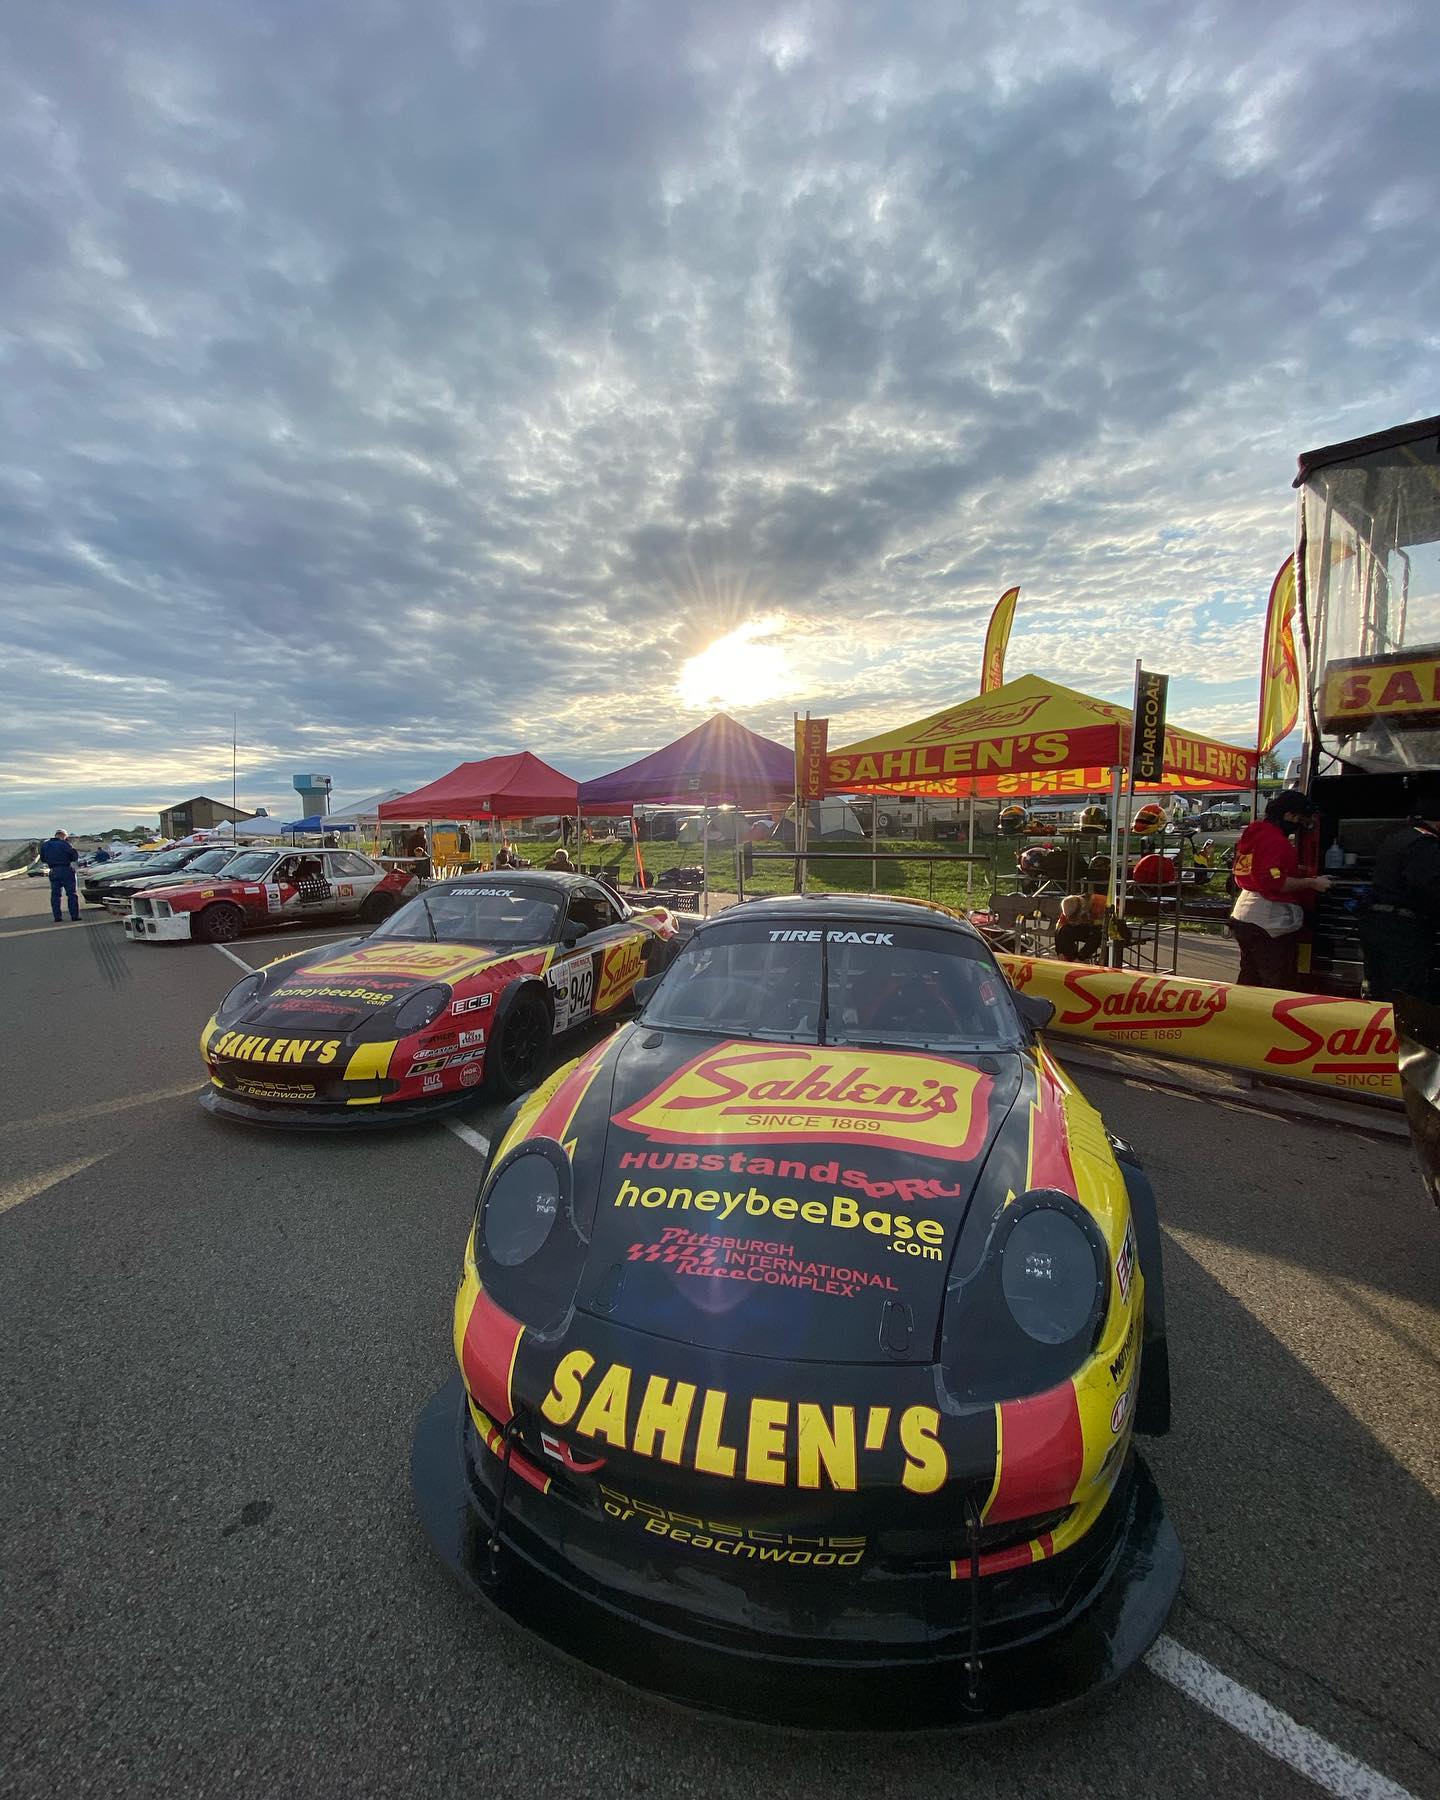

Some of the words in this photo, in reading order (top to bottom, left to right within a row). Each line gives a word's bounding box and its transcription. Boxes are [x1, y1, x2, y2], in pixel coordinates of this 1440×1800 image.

[1141, 677, 1161, 777] CHARCOAL
[809, 724, 820, 796] KETCHUP
[829, 733, 1070, 783] SAHLEN'S
[1163, 737, 1247, 781] AHLEN'S
[477, 889, 514, 897] RACK
[769, 930, 823, 942] TIRE
[826, 931, 895, 946] RACK
[271, 988, 394, 1002] honeybeeBase
[456, 996, 489, 1013] ECS
[570, 970, 592, 1013] 942
[1059, 969, 1231, 1024] Sahlen's
[214, 1031, 342, 1064] SAHLEN'S
[1109, 1030, 1148, 1041] SINCE
[1153, 1029, 1183, 1040] 1869
[450, 1048, 486, 1064] PFC
[248, 1087, 316, 1099] Beachwood
[661, 1051, 958, 1115] Sahlen's
[1336, 1074, 1393, 1087] SINCE
[745, 1114, 820, 1128] SINCE
[832, 1117, 881, 1132] 1869
[613, 1179, 945, 1244] honeybeeBase
[886, 1240, 943, 1262] .com
[724, 1251, 899, 1292] INTERNATIONAL
[540, 1349, 950, 1496] SAHLEN'S
[604, 1501, 635, 1521] of
[644, 1517, 865, 1566] Beachwood
